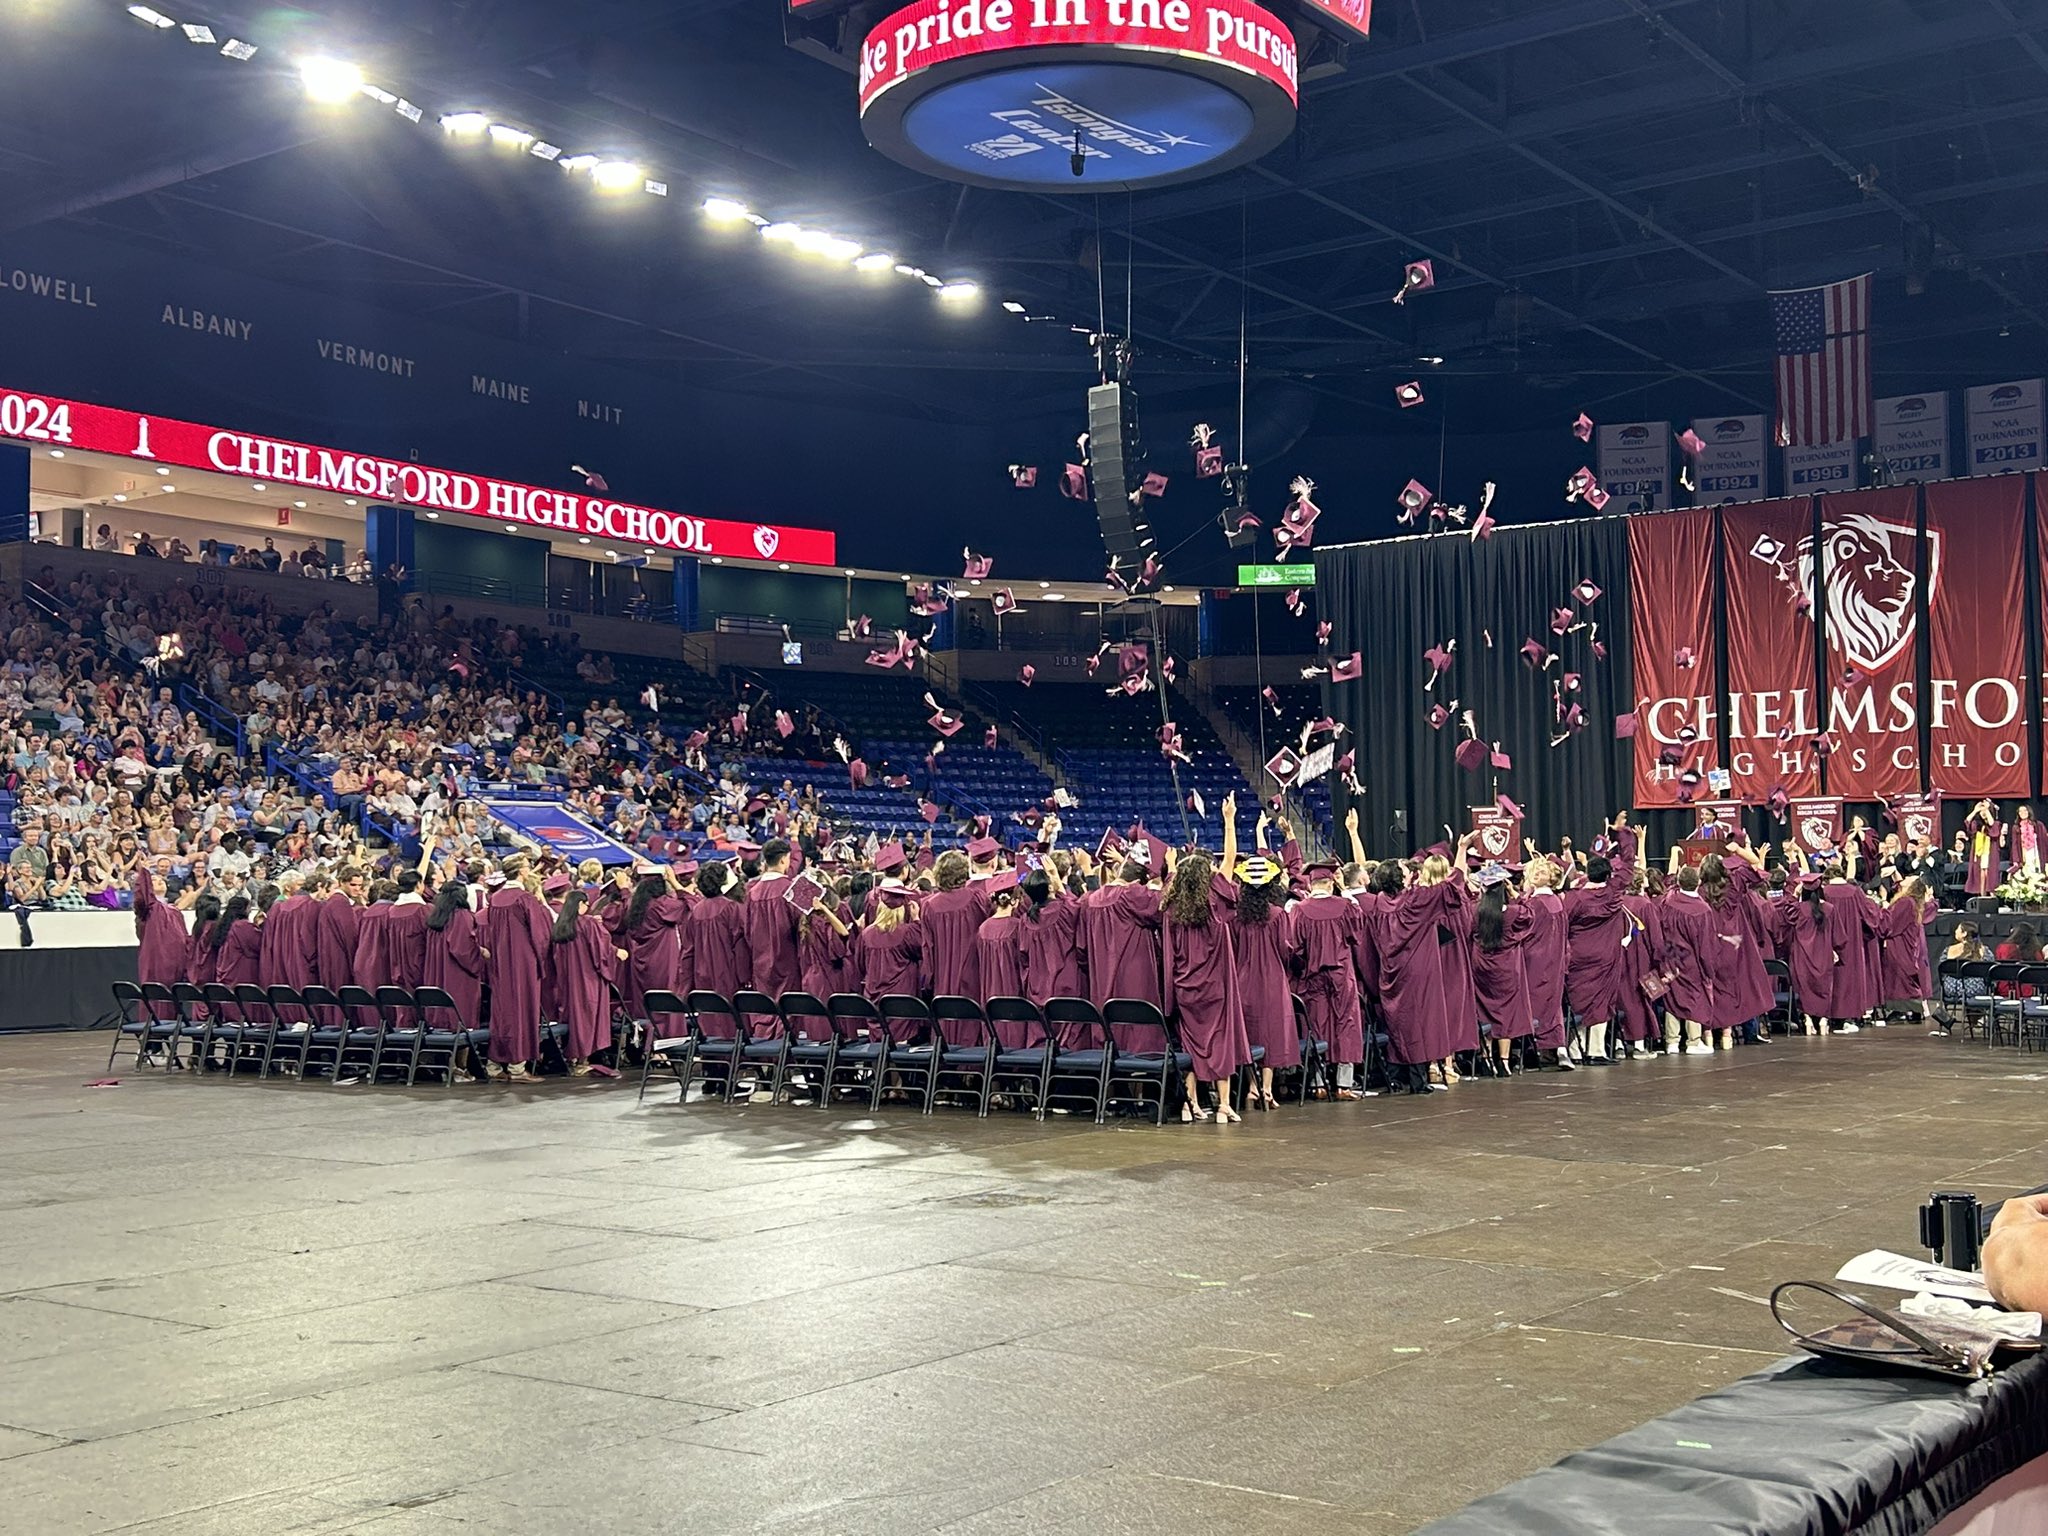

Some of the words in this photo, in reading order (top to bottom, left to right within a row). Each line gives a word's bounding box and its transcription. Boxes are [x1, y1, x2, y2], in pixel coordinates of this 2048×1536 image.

[894, 0, 1014, 75] pride
[1030, 0, 1090, 28] in
[1107, 0, 1191, 33] the
[990, 109, 1113, 159] Center
[1032, 96, 1167, 155] Tsongas
[0, 266, 97, 307] LOWELL
[162, 304, 252, 341] ALBANY
[316, 339, 415, 378] VERMONT
[471, 375, 530, 404] MAINE
[0, 394, 73, 443] 024
[577, 400, 623, 425] NJIT
[1992, 418, 2019, 428] NCAA
[1897, 430, 1924, 440] NCAA
[1973, 427, 2040, 443] TOURNAMENT
[1879, 438, 1943, 453] TOURNAMENT
[1984, 444, 2030, 462] 2013
[1621, 457, 1647, 465] NCAA
[1716, 451, 1742, 459] NCAA
[1790, 449, 1851, 464] TOURNAMENT
[1890, 455, 1934, 471] 2012
[1603, 466, 1665, 476] TOURNAMENT
[1801, 466, 1843, 482] 1996
[207, 431, 480, 510] CHELMSFORD
[486, 481, 580, 529] HIGH
[586, 499, 713, 552] SCHOOL
[1614, 481, 1658, 495] 19
[1709, 476, 1752, 491] 1994
[1647, 676, 2028, 746] CHELMSFO
